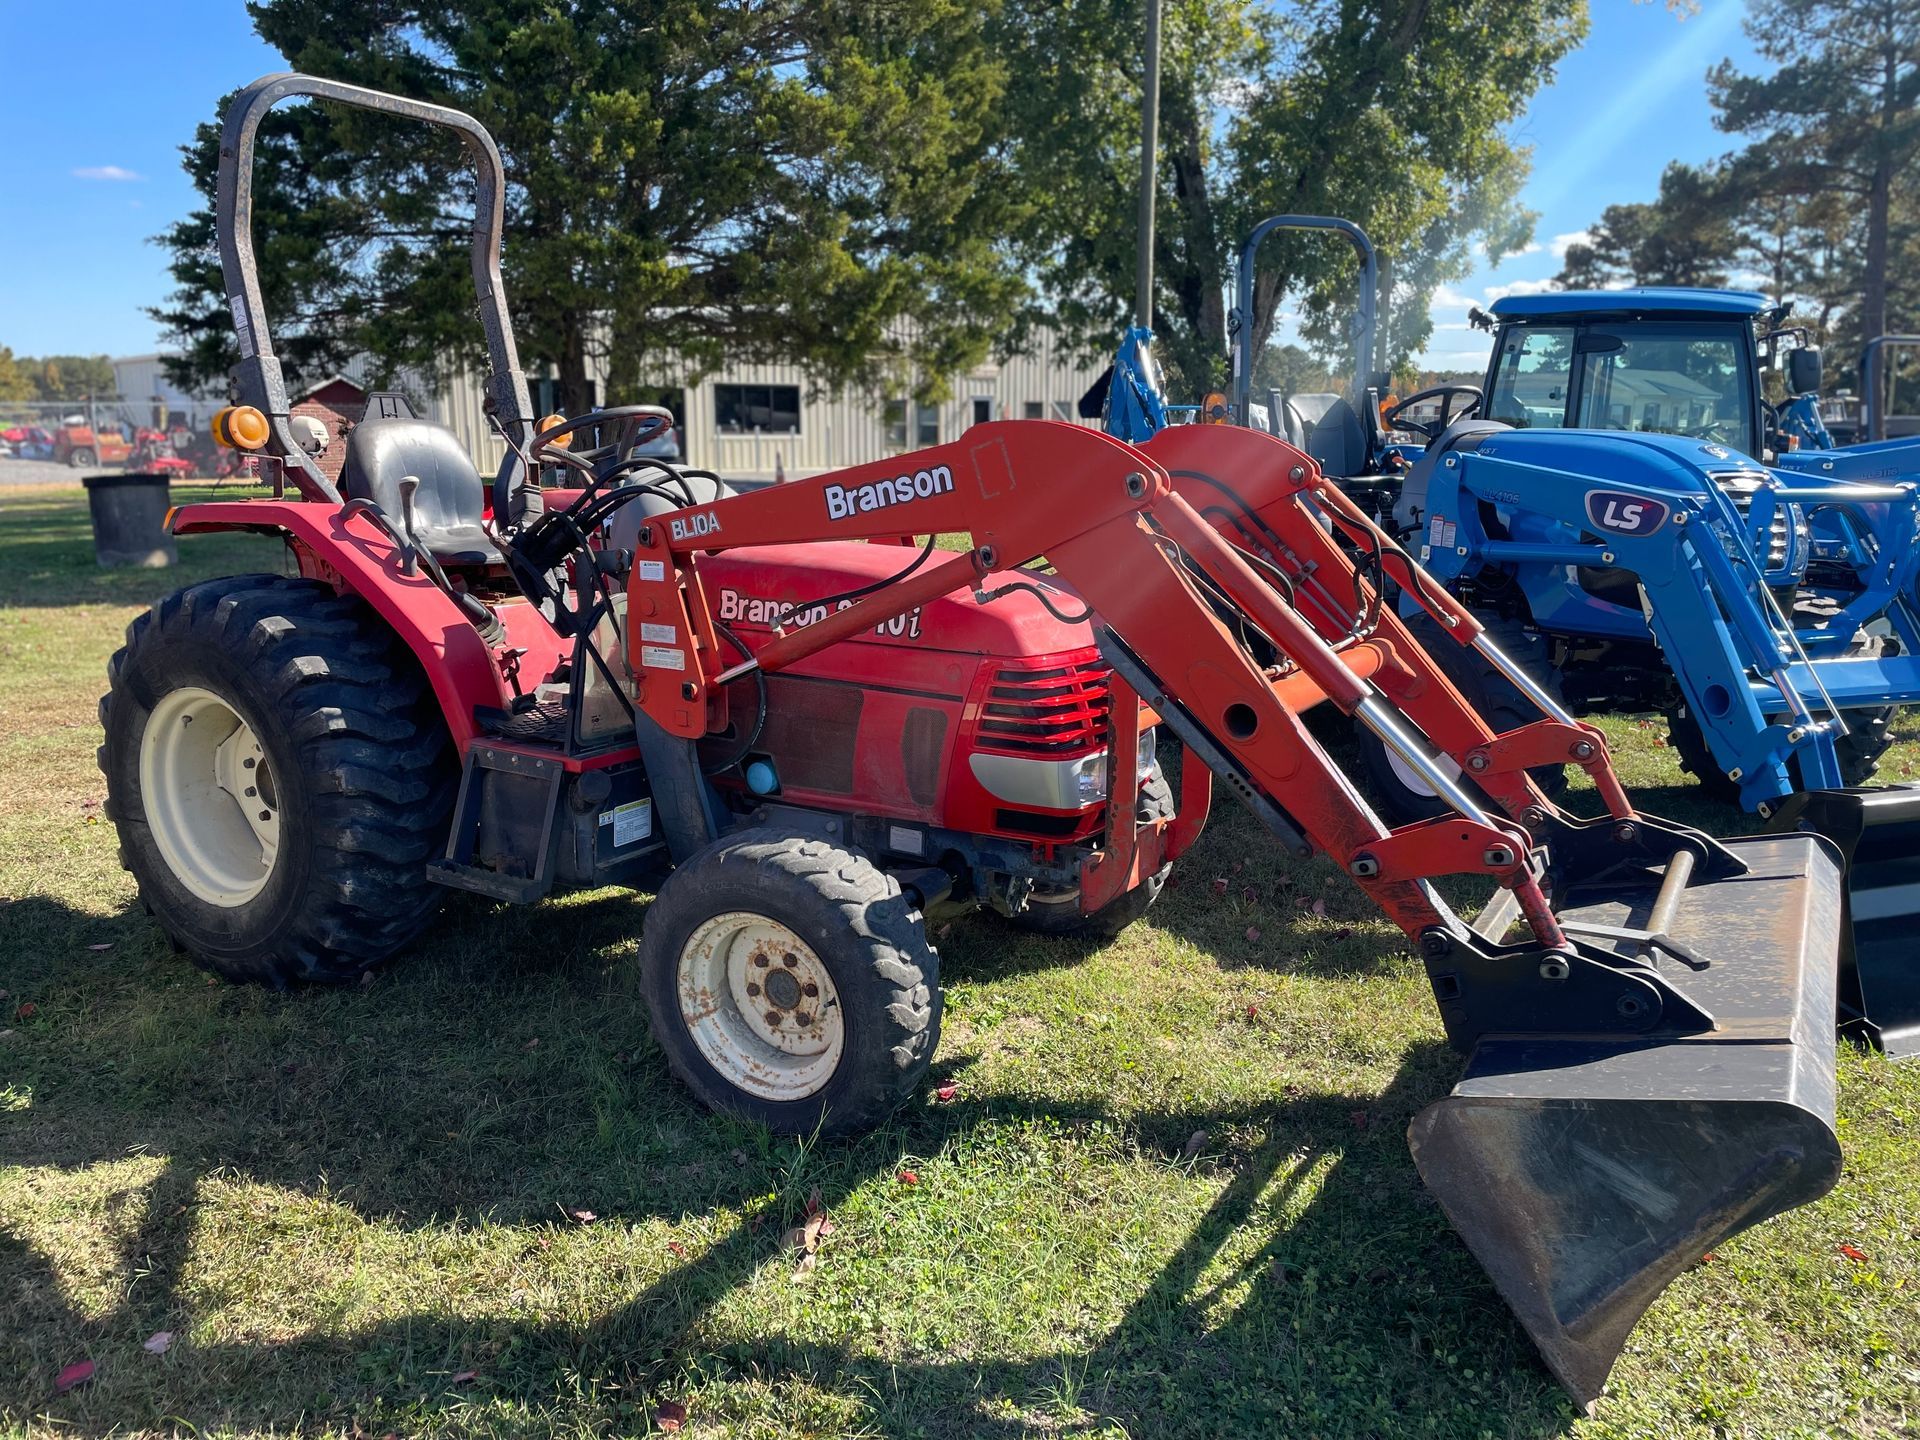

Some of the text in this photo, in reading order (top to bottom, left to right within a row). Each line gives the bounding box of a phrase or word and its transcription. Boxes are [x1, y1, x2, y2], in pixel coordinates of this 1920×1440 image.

[824, 465, 954, 519] Branson
[670, 511, 721, 540] BL10A
[1602, 500, 1644, 530] LS
